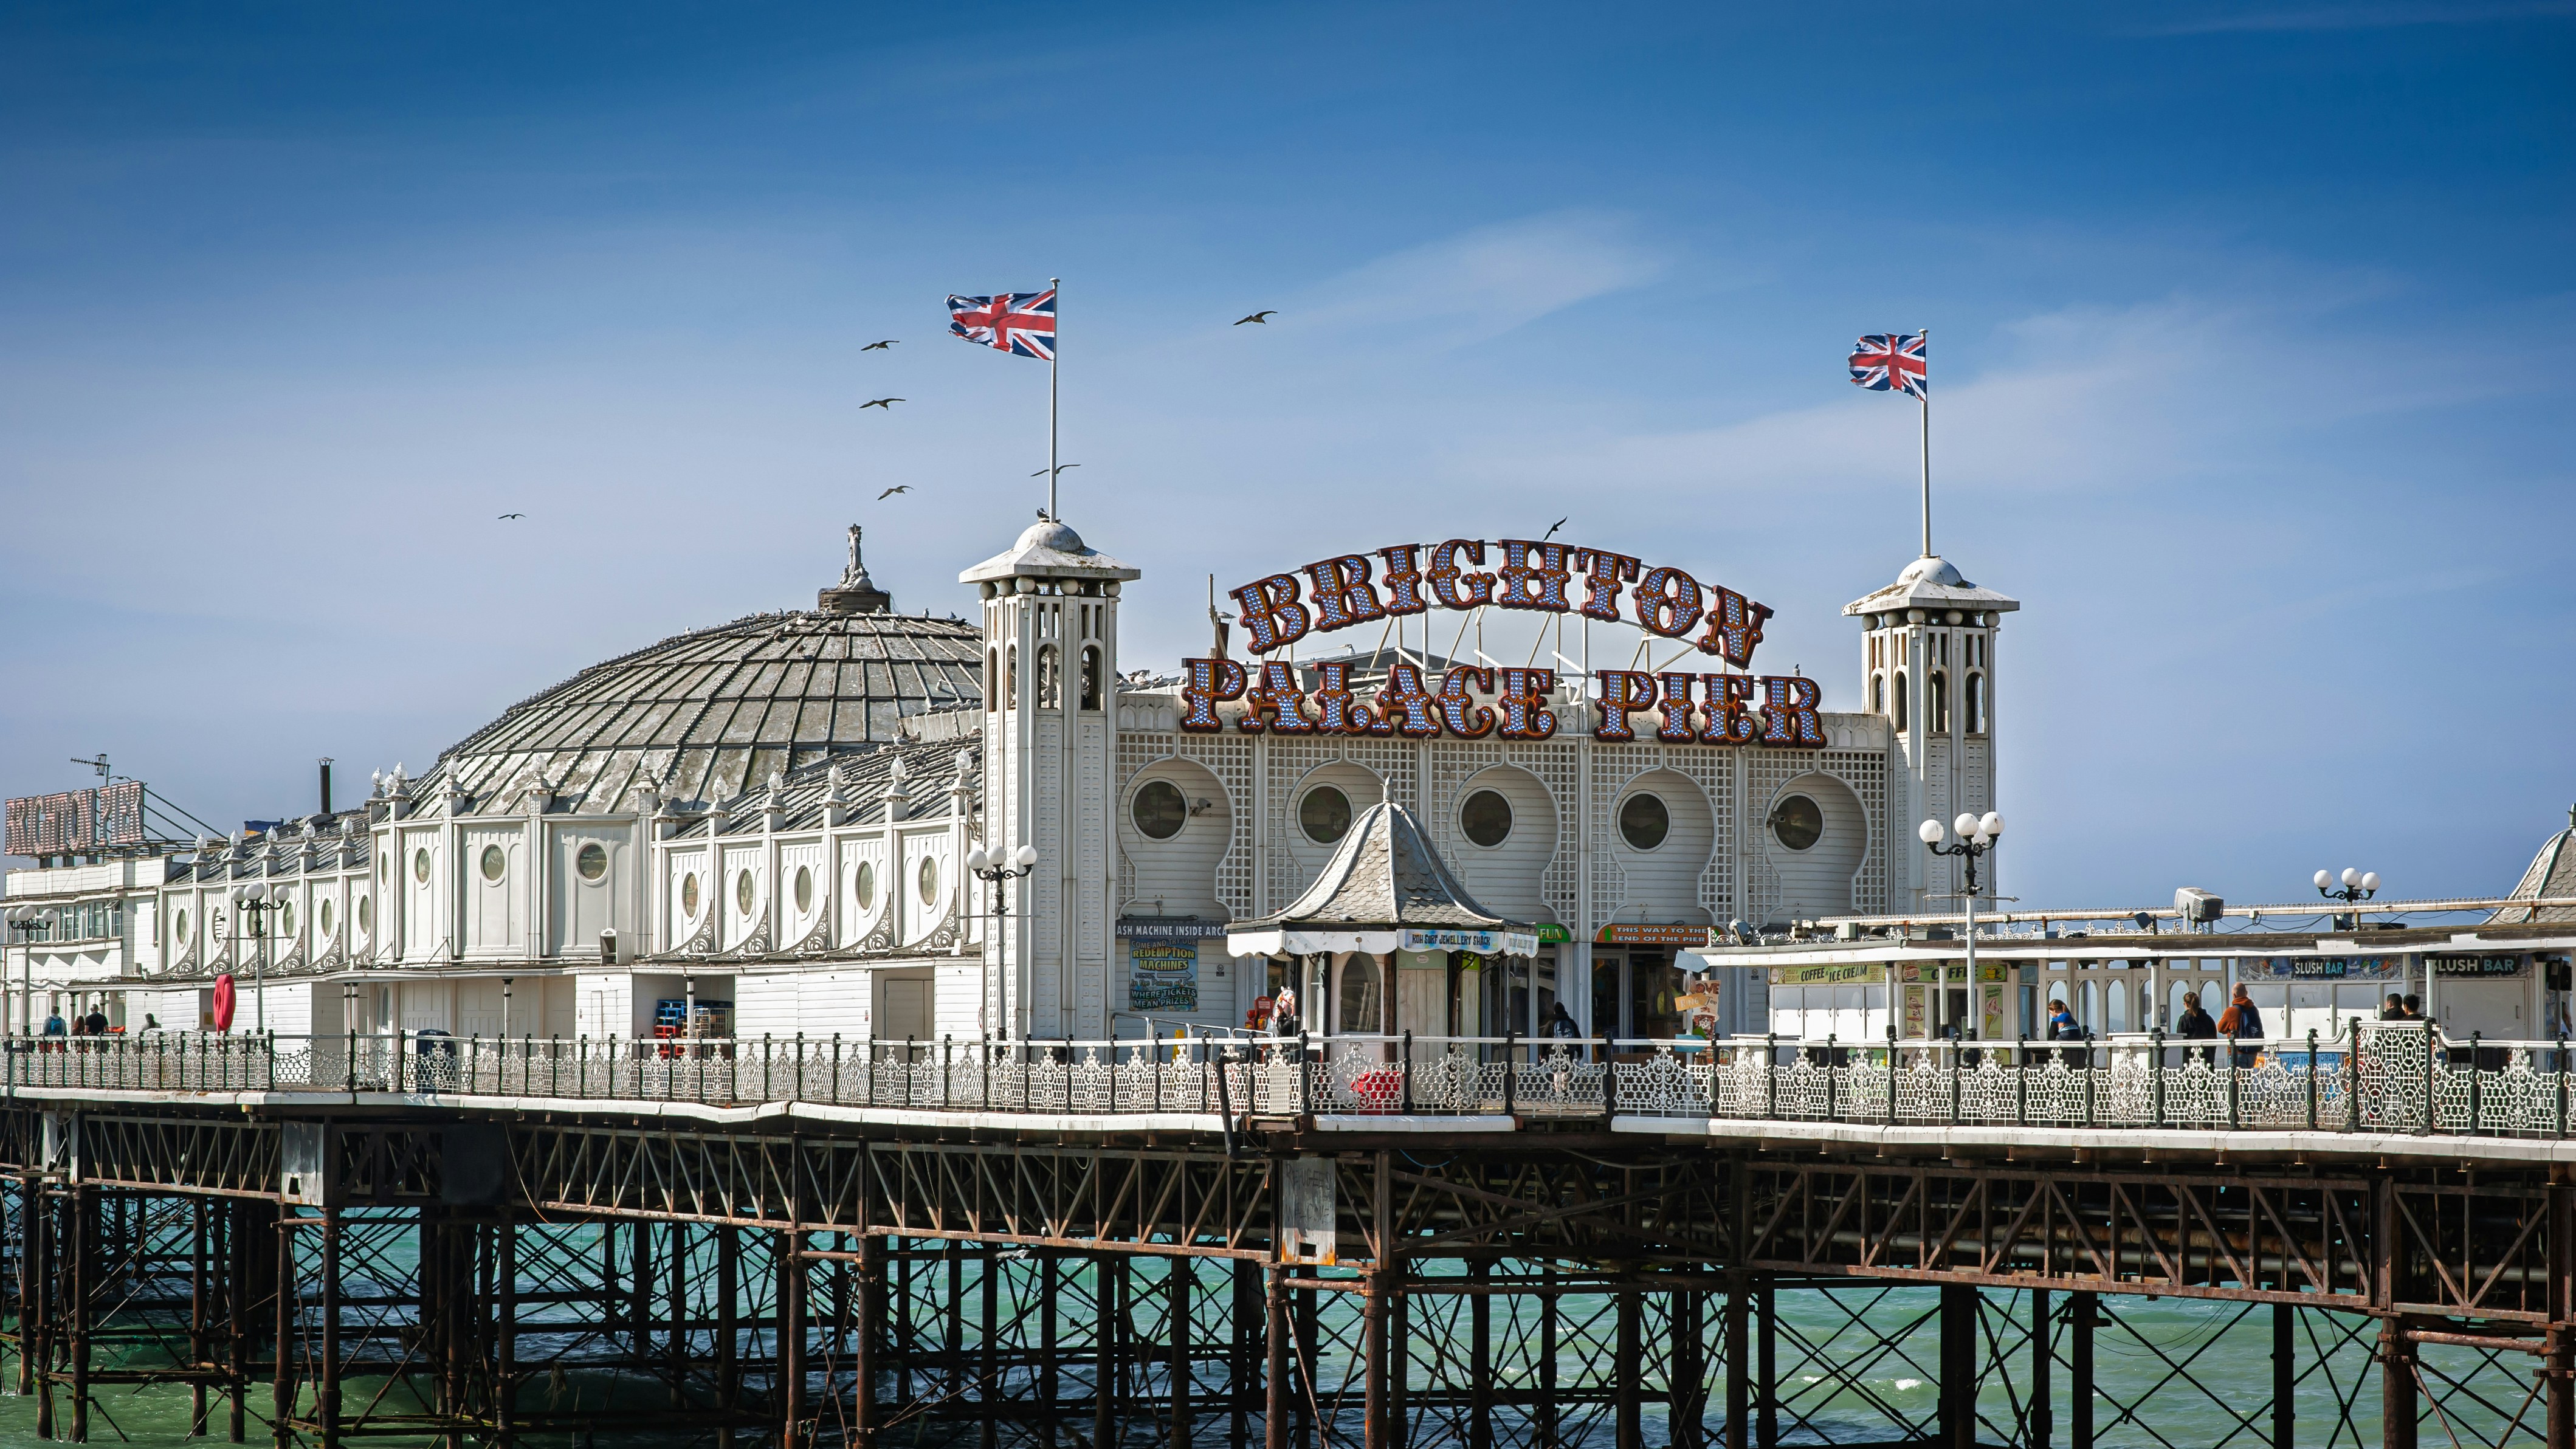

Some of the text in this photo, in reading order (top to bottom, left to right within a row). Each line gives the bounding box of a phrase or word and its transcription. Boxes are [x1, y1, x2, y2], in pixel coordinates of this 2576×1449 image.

[1228, 539, 1773, 669] BRIGHTON
[1180, 658, 1827, 749] PALACE PIER
[1136, 926, 1173, 935] MACHINE
[1176, 926, 1202, 936] INSIDE
[1540, 928, 1562, 940] FUN
[1152, 940, 1166, 948] AND
[1412, 934, 1490, 946] KOH SURF JEWELLERY SHACK
[1132, 947, 1194, 958] REDEMPTION
[1139, 960, 1188, 970] MACHINES
[2295, 962, 2343, 974] SLUSH BAR
[2435, 959, 2514, 971] LUSH BAR
[1800, 967, 1825, 982] COFFEE
[1828, 970, 1841, 982] ICE
[1843, 965, 1867, 980] CREAM
[1131, 988, 1196, 998] WHERE TICKETS
[1134, 999, 1159, 1008] MEAN
